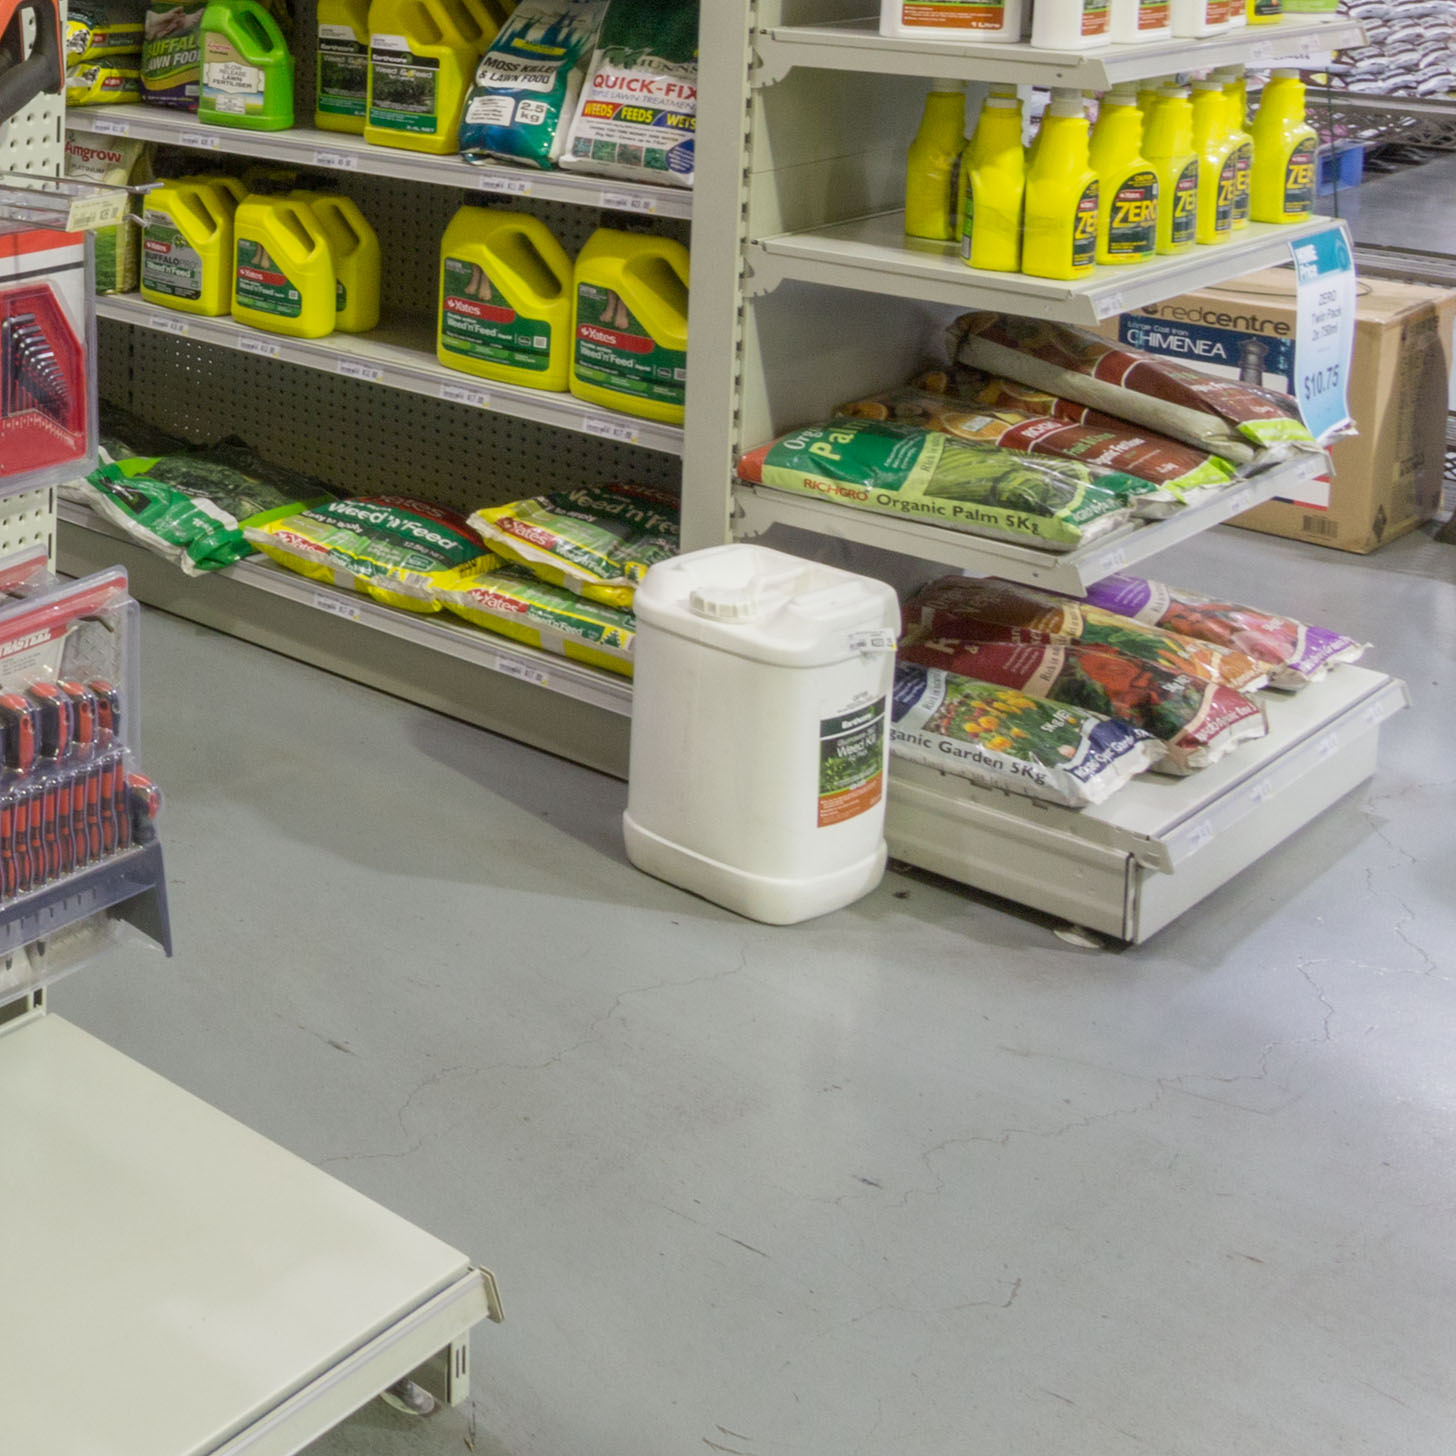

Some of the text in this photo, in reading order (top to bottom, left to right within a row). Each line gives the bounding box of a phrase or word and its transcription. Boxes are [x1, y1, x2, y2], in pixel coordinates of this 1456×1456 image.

[375, 66, 398, 75] Weed
[484, 57, 518, 72] MOSS
[212, 79, 253, 89] FERTILISER
[222, 75, 243, 83] LAWN
[489, 73, 519, 83] LAWN
[521, 74, 551, 85] FOOD
[593, 74, 697, 100] QUICK-FIX
[520, 102, 545, 113] 2.5
[585, 101, 614, 118] WEEDS
[620, 106, 653, 123] FEEDS
[520, 111, 540, 123] kg
[666, 112, 696, 130] WETS
[65, 141, 122, 163] Amgrow
[1318, 290, 1337, 306] ZERO
[454, 299, 481, 316] Yates
[1311, 306, 1342, 326] Twin Pack
[1161, 303, 1291, 335] redcentre
[588, 328, 617, 345] Yates
[1127, 321, 1189, 336] Large Cast Iron
[1126, 329, 1227, 359] CHIMENEA
[1303, 364, 1340, 400] $10.75
[803, 478, 1040, 535] RICHGRO Organic Palm 5Kg
[303, 510, 363, 533] Easy to apply
[328, 502, 457, 550] Weed'n'Feed
[511, 520, 548, 545] Yates
[482, 593, 520, 613] Yates
[888, 727, 1046, 787] ganic Garden 5Kg
